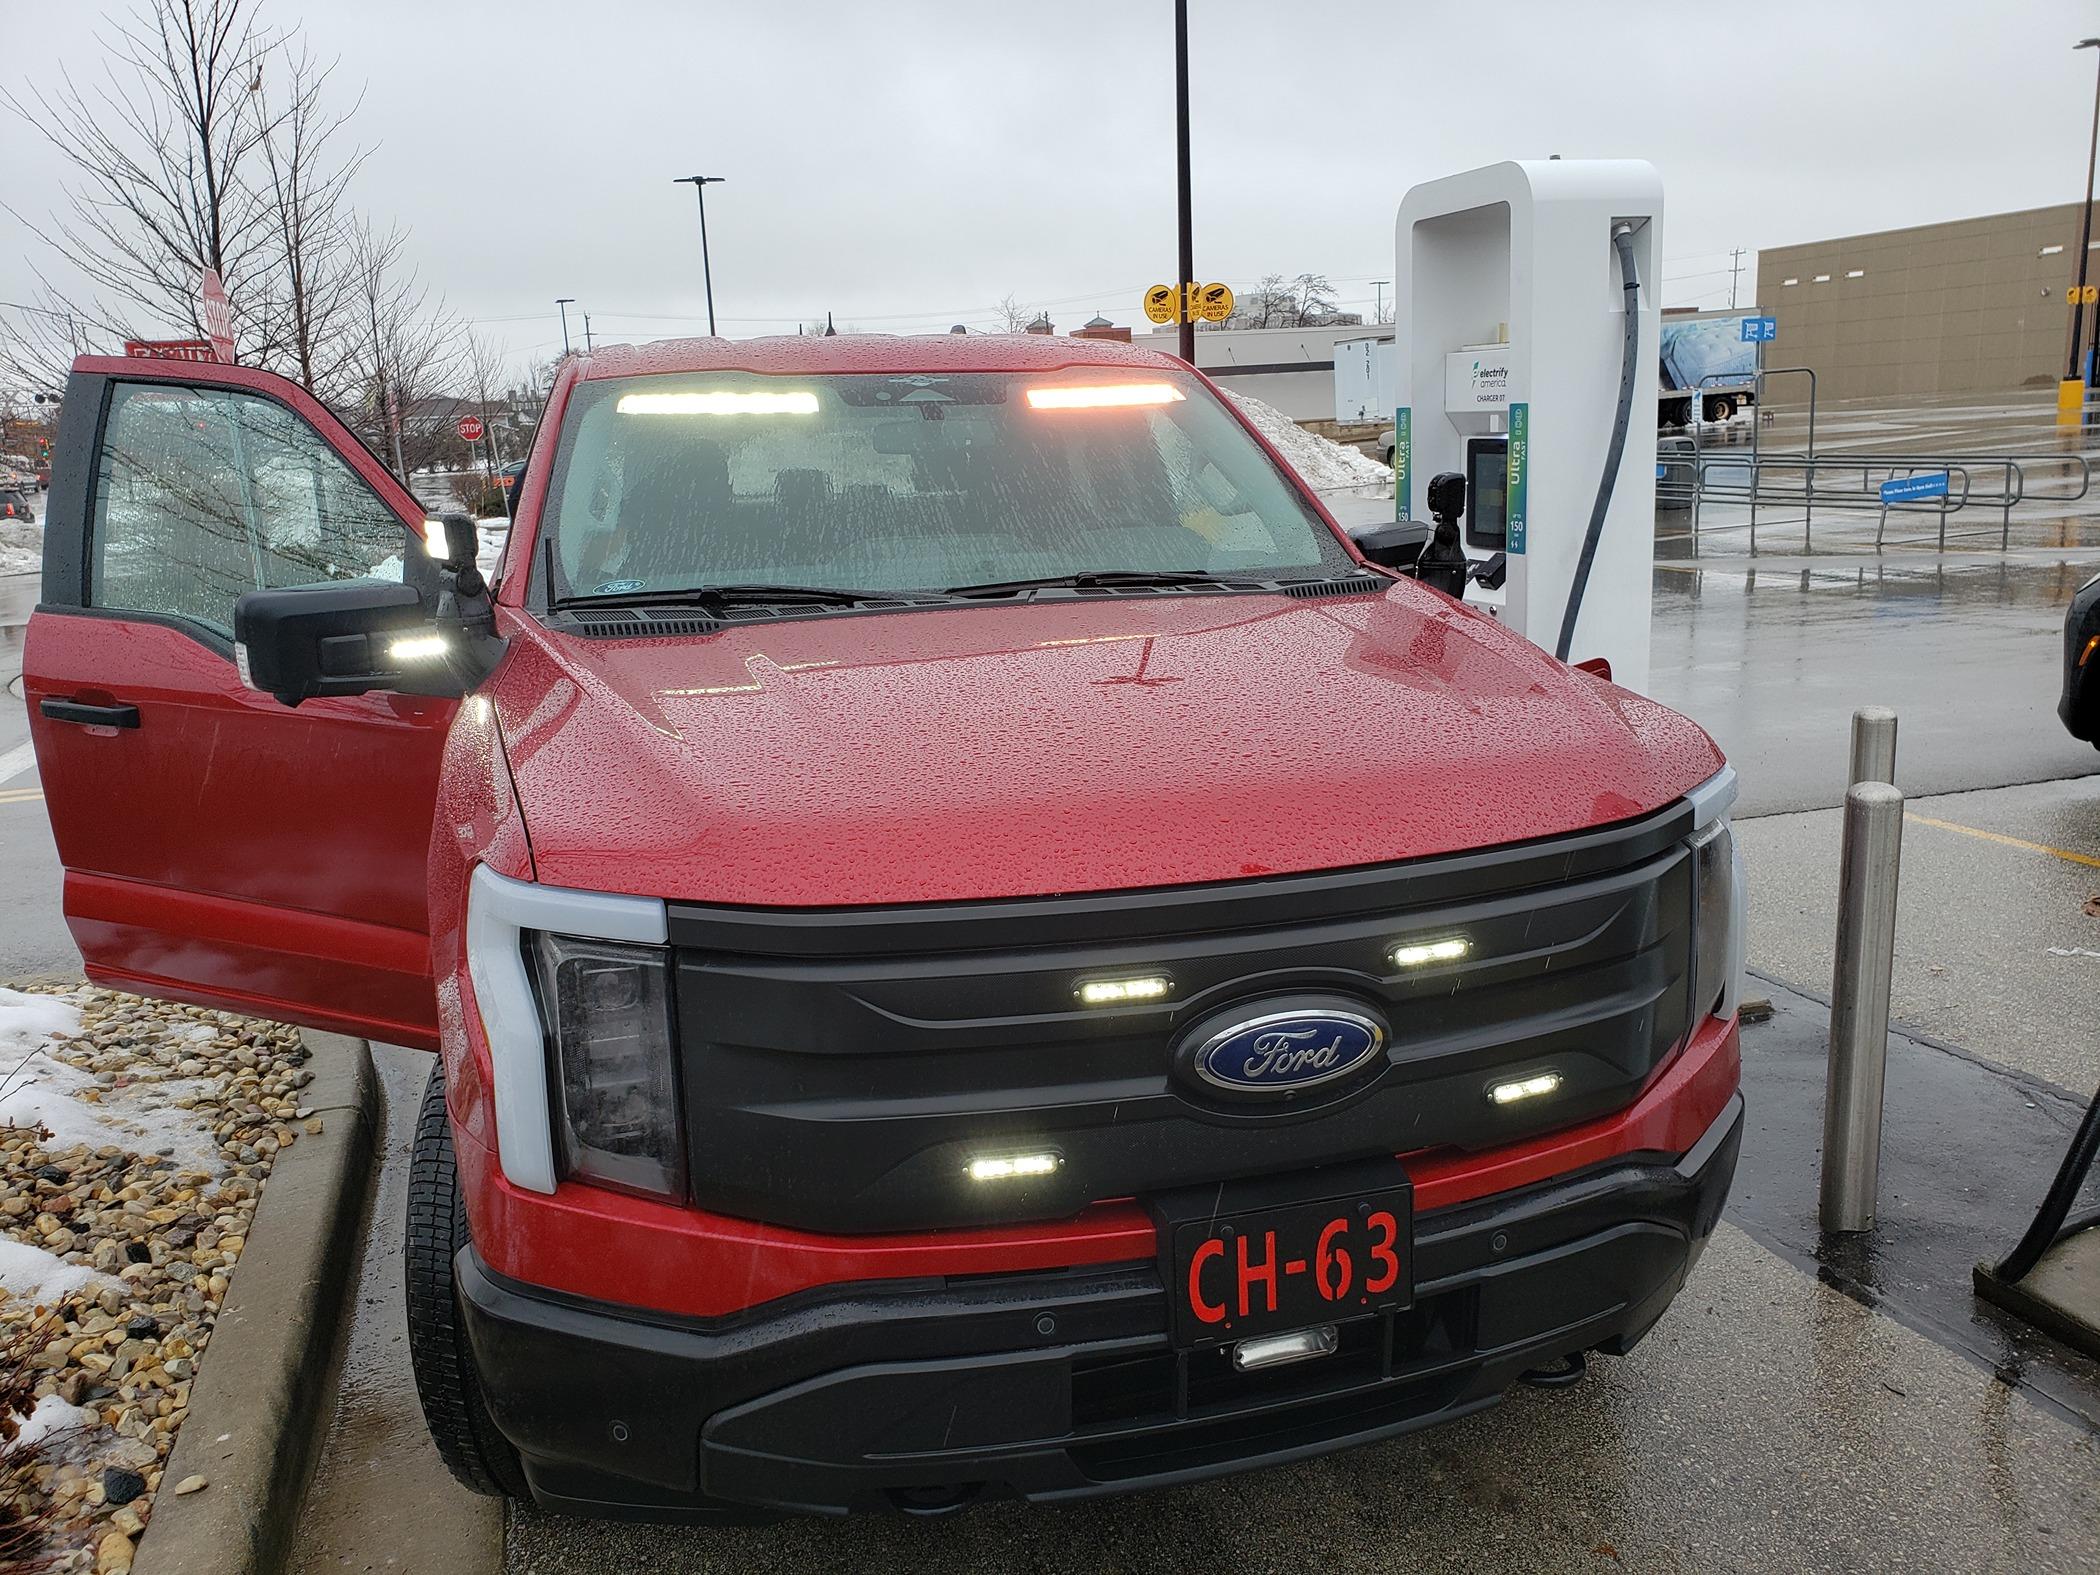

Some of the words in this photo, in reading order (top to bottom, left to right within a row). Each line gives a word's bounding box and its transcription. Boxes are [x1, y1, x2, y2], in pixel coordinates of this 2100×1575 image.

[205, 298, 230, 338] STOP
[1480, 367, 1508, 379] electrify
[1476, 394, 1499, 402] CHARGER
[460, 423, 481, 434] STOP
[1398, 441, 1406, 480] Ultra
[1510, 441, 1521, 485] Ultra
[1398, 512, 1409, 522] 150
[1510, 521, 1523, 532] 150
[604, 582, 633, 593] Ford
[1241, 1027, 1343, 1078] Ford
[1186, 1210, 1401, 1325] CH-63
